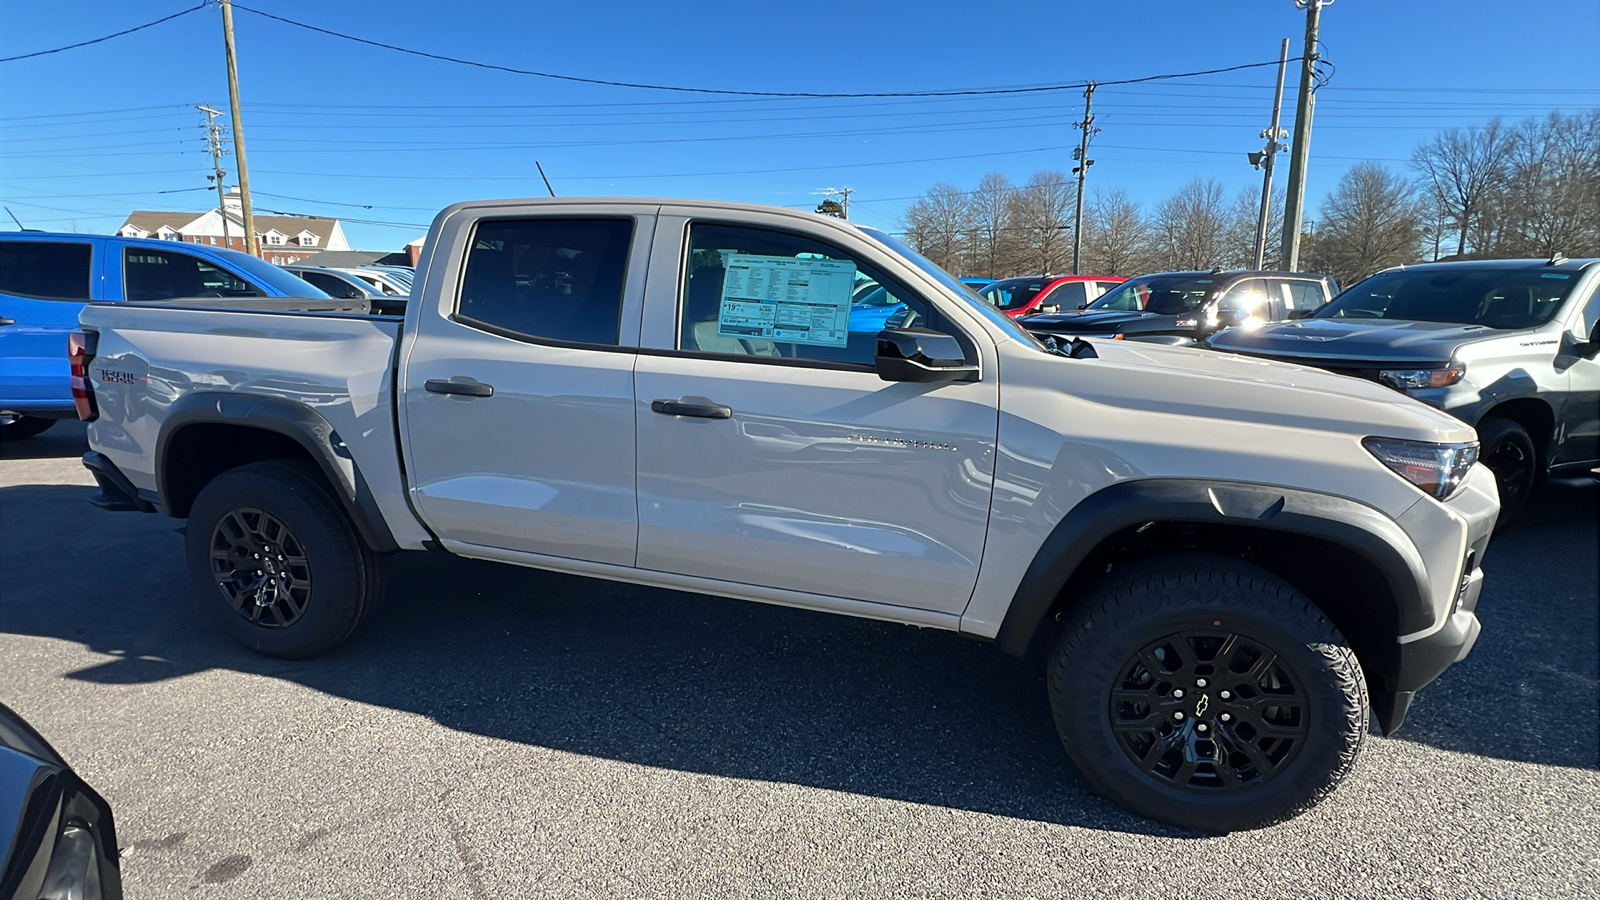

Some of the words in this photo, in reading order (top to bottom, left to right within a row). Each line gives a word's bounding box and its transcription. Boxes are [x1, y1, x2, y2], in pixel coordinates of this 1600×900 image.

[728, 303, 736, 311] 19
[96, 368, 138, 381] TRAIL
[102, 376, 134, 385] BOSS
